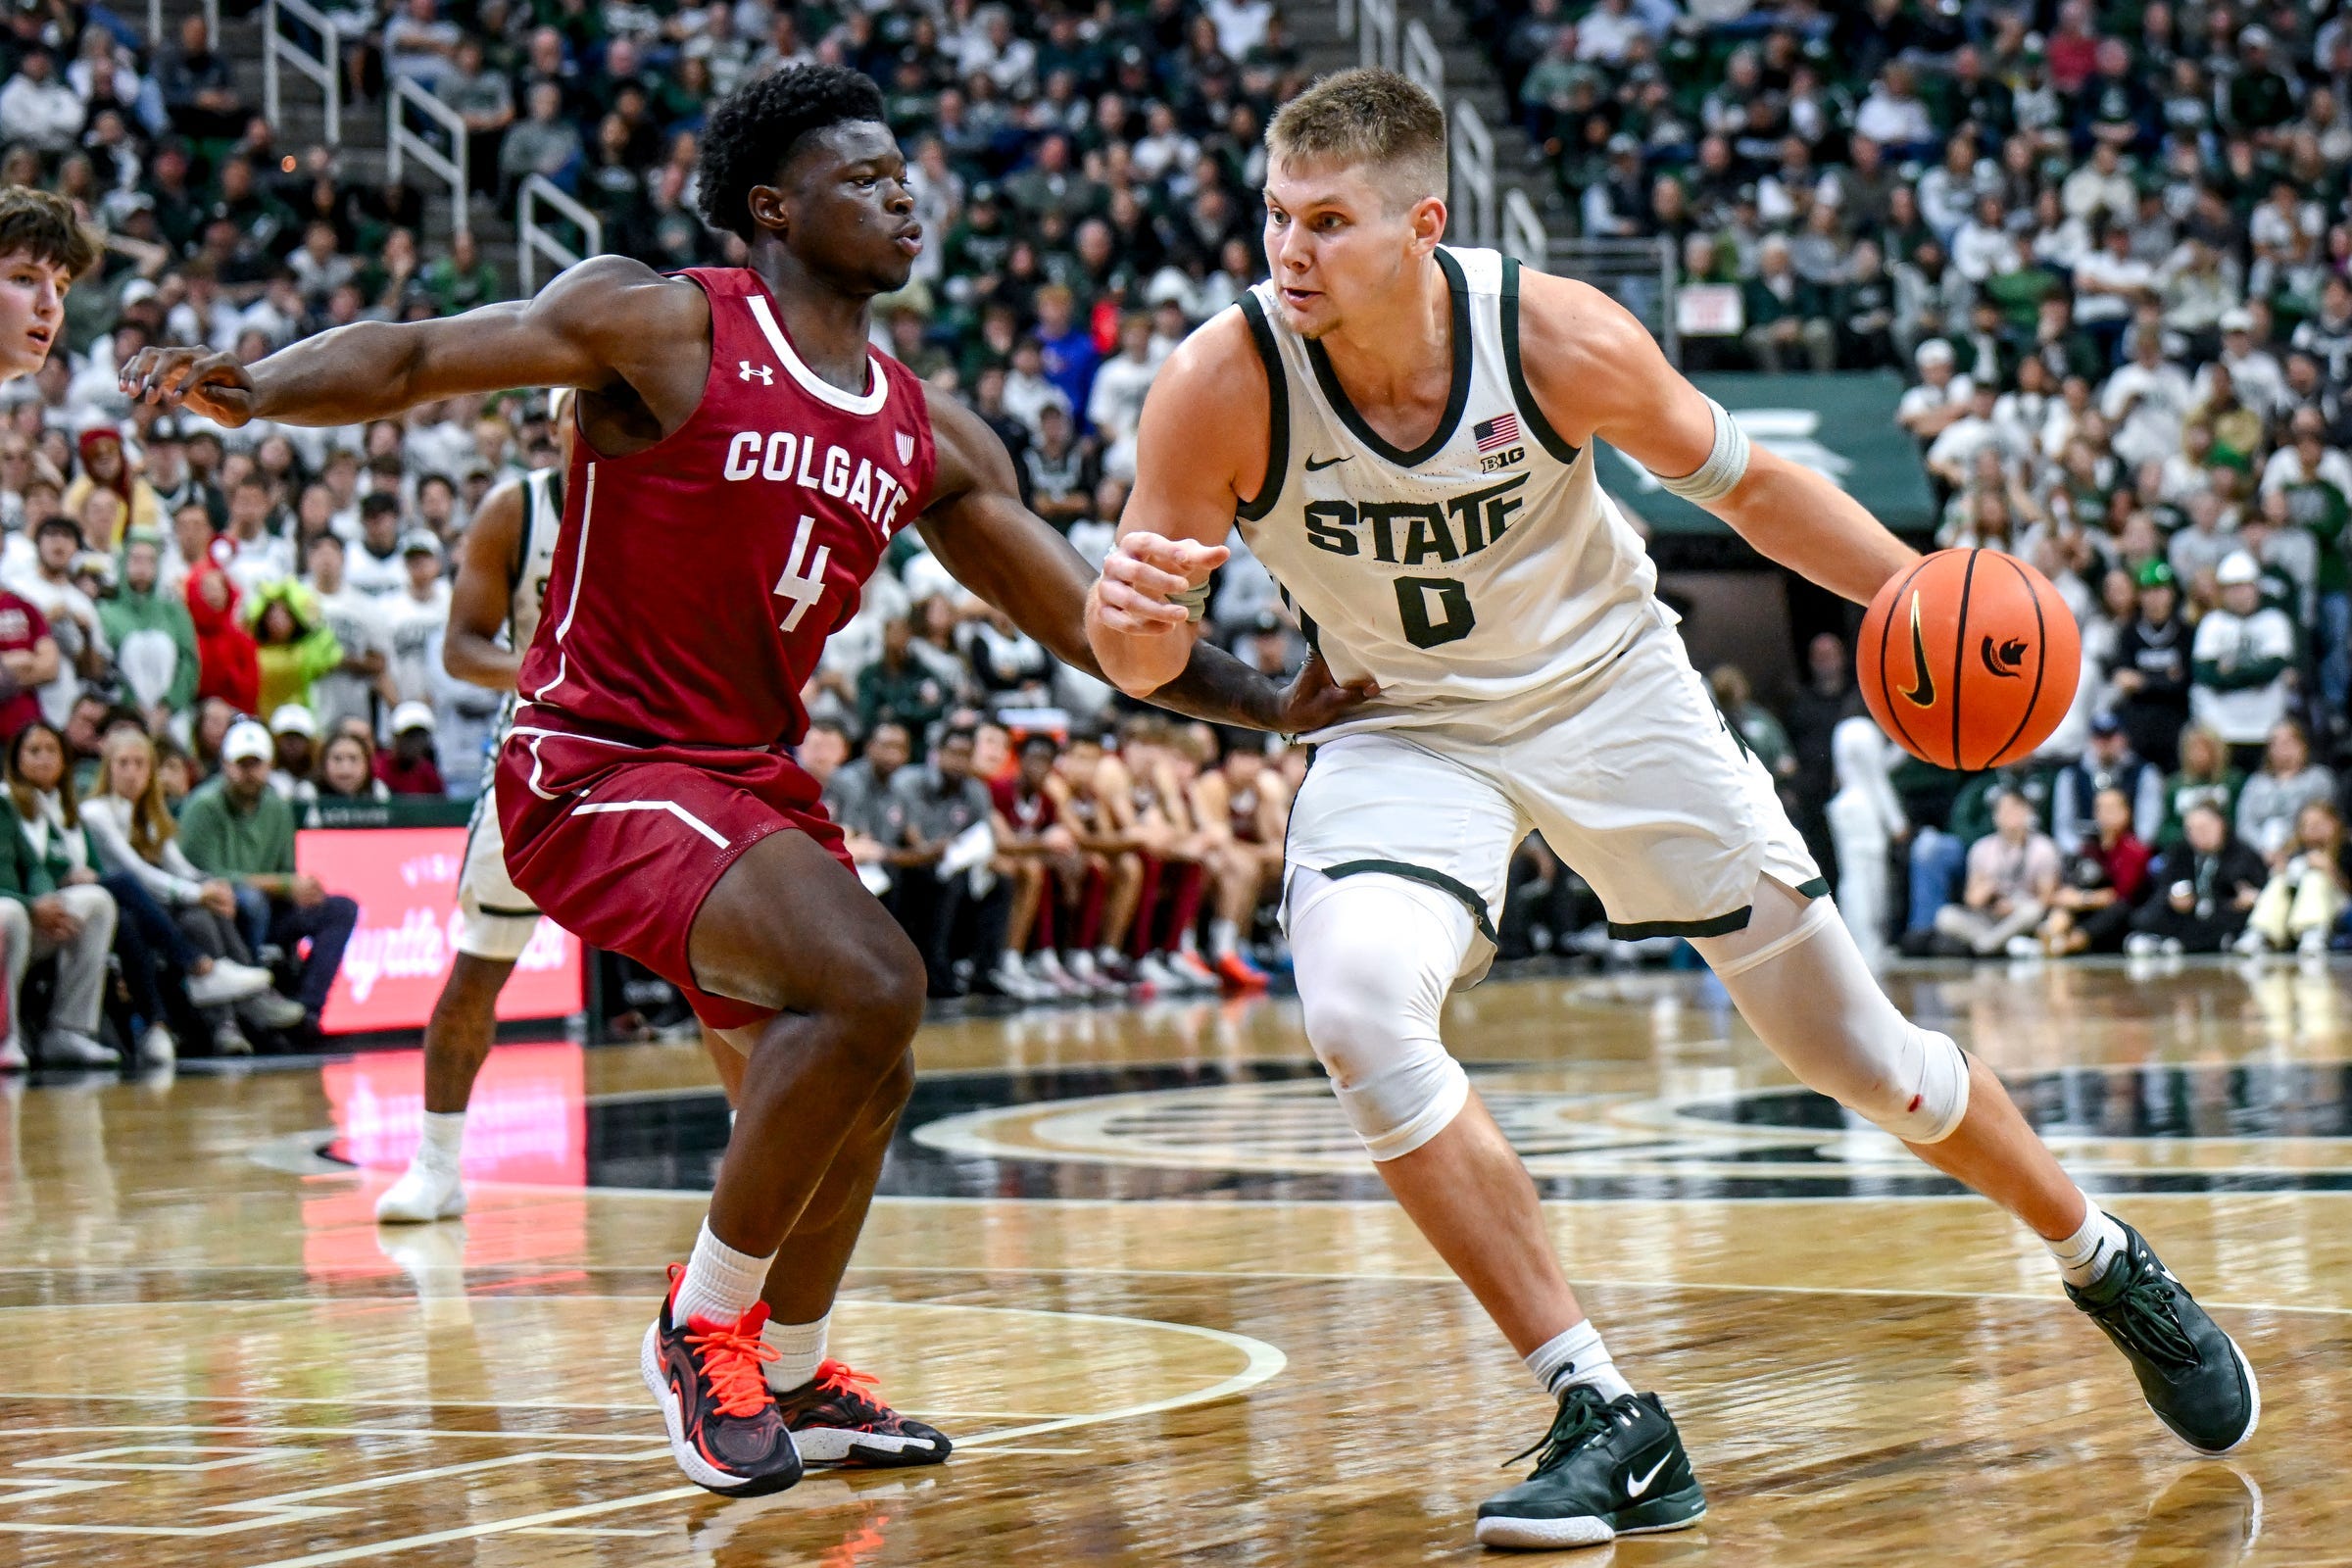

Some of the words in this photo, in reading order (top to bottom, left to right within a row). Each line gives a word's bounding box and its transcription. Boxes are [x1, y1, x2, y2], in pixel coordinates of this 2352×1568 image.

[723, 431, 908, 541] COLGATE
[1304, 471, 1531, 564] STATE
[773, 515, 831, 632] 4
[1394, 575, 1476, 650] 0
